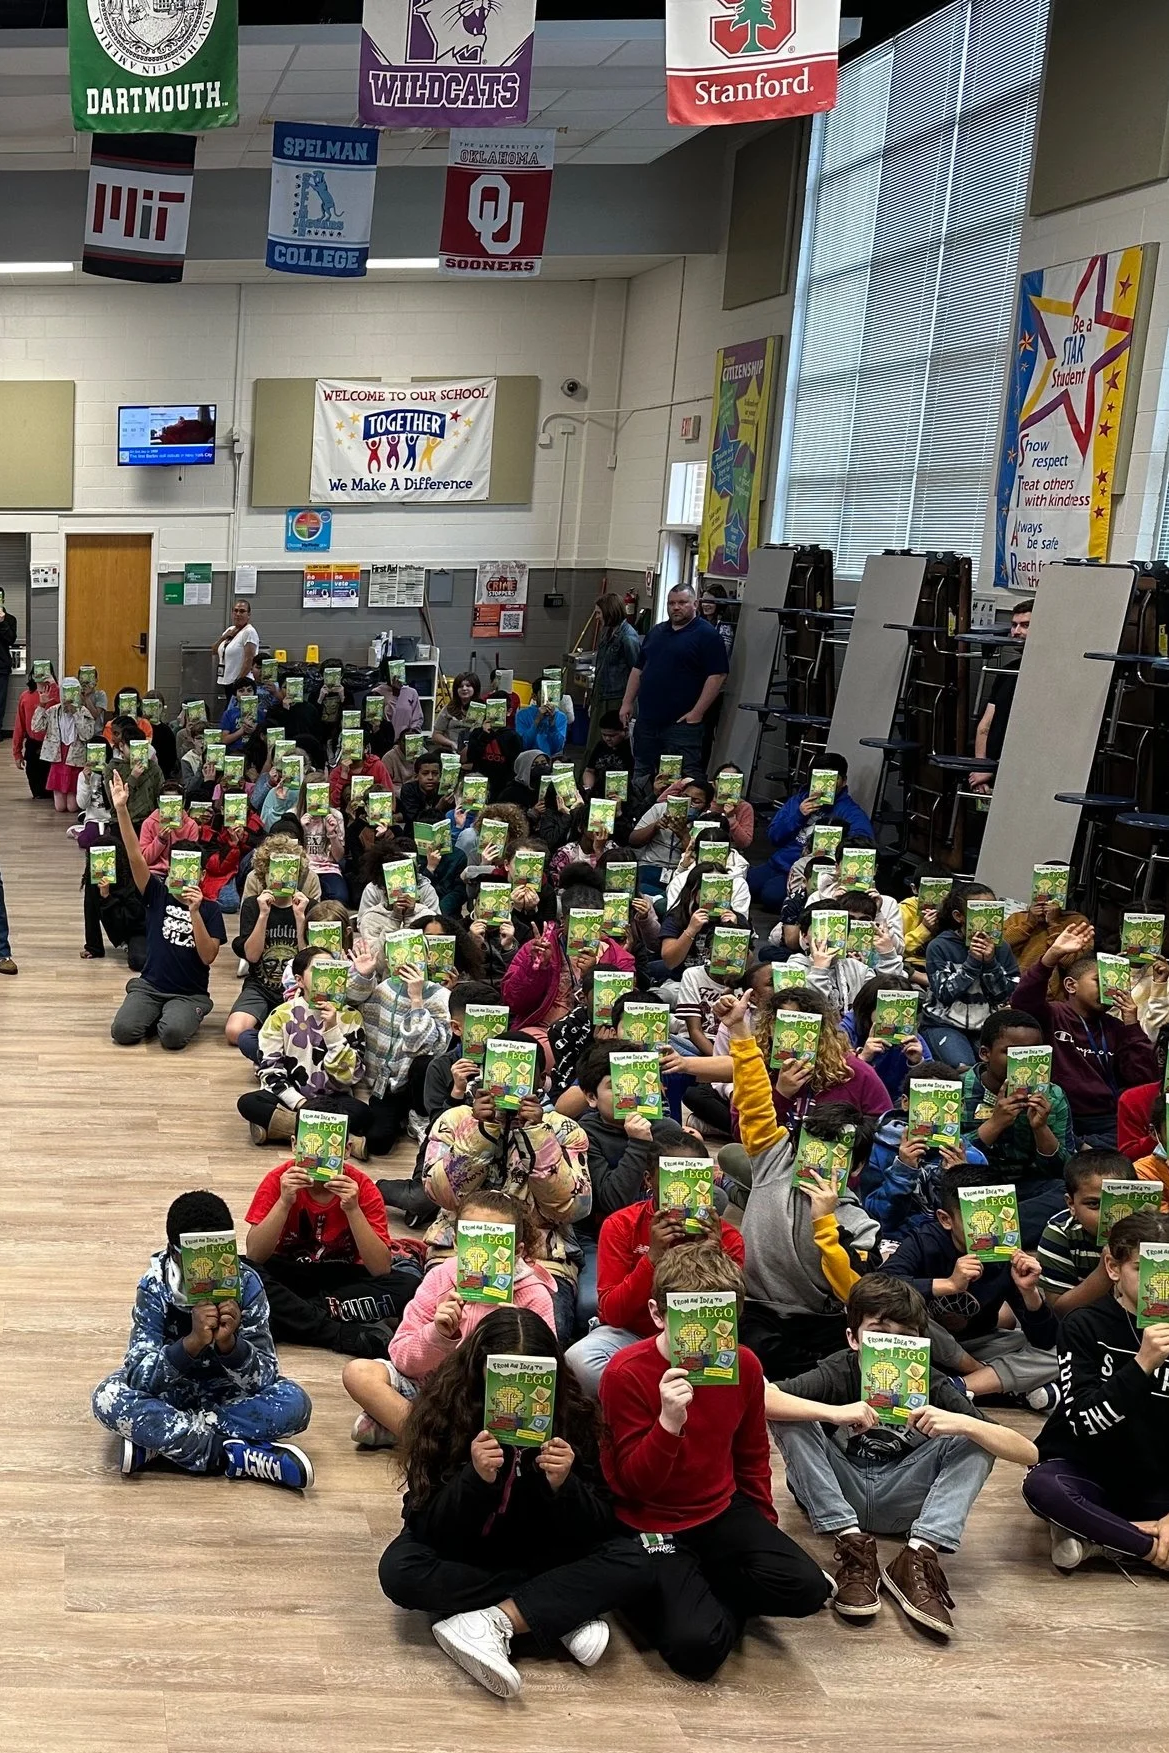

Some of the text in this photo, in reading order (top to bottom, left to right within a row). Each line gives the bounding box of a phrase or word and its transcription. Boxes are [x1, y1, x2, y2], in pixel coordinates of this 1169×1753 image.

[94, 17, 138, 70] AMERICA
[142, 65, 157, 74] IN
[369, 70, 520, 109] WILDCATS
[86, 81, 221, 115] DARTMOUTH
[283, 137, 369, 162] SPELMAN
[460, 149, 539, 165] OKLAHOMA
[468, 174, 524, 255] OU
[274, 245, 360, 269] COLLEGE
[445, 258, 535, 272] SOONERS
[1072, 315, 1093, 334] Be a
[1061, 334, 1086, 367] STAR
[722, 359, 764, 382] CITIZENSHIP
[1051, 368, 1086, 388] Student
[323, 387, 489, 402] WELCOME TO OUR SCHOOL
[368, 412, 441, 435] TOGETHER
[1018, 433, 1049, 467] Show
[1032, 455, 1068, 471] respect
[328, 476, 473, 492] We Make A Difference
[1016, 475, 1074, 508] Treat others
[1024, 493, 1091, 507] with kindness
[1010, 517, 1043, 547] Always
[1027, 537, 1059, 550] be safe
[371, 564, 387, 574] First
[387, 563, 398, 574] Aid
[1010, 553, 1036, 585] Reach
[487, 581, 517, 591] CRIME
[984, 1196, 1014, 1206] LEGO
[481, 1235, 511, 1245] LEGO
[673, 1298, 689, 1306] FROM
[700, 1296, 713, 1304] IDEA
[697, 1307, 733, 1318] LEGO
[893, 1338, 907, 1346] IDEA
[890, 1346, 927, 1361] LEGO
[520, 1362, 533, 1371] IDEA
[515, 1373, 552, 1385] LEGO
